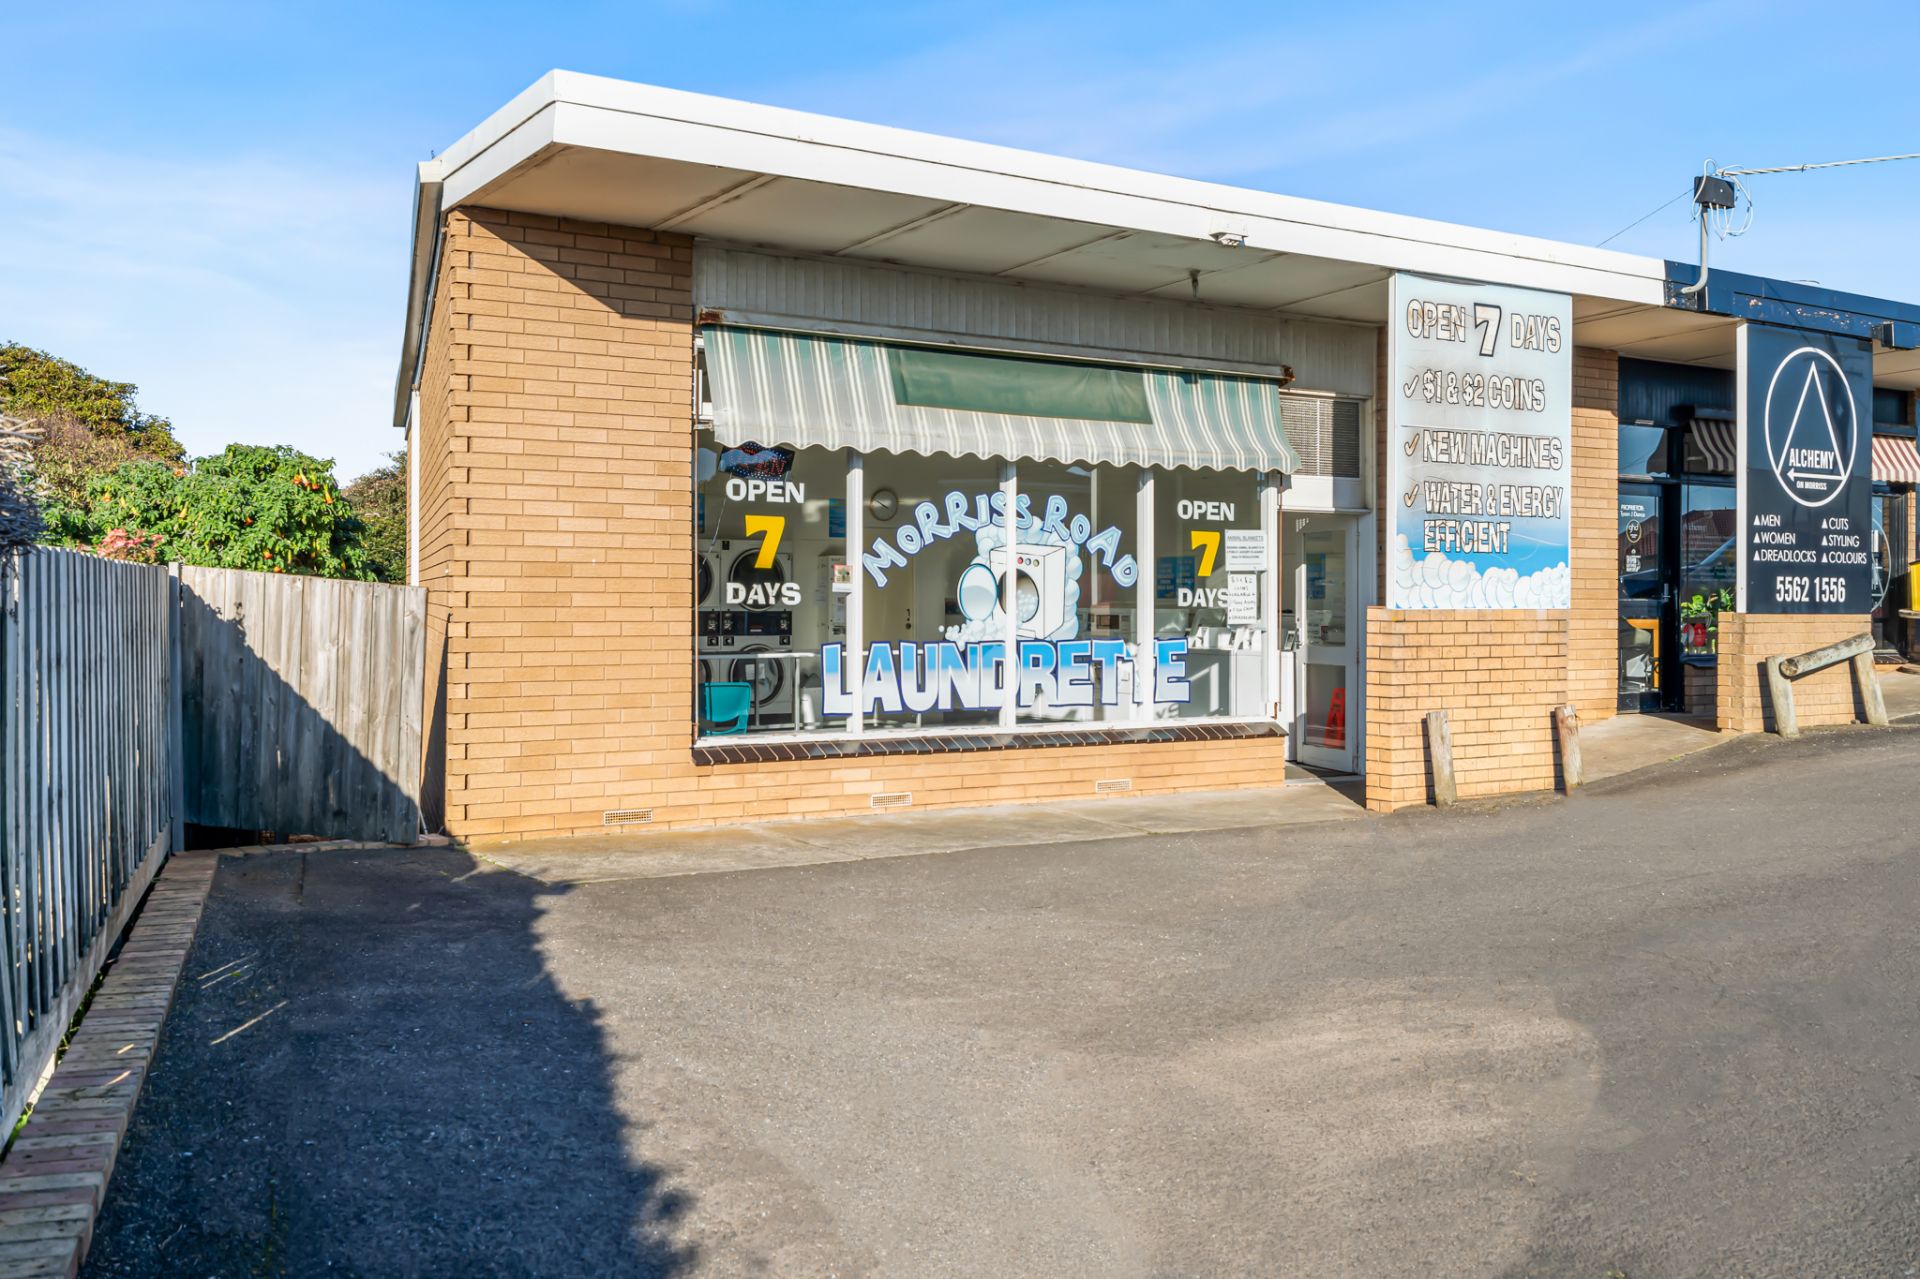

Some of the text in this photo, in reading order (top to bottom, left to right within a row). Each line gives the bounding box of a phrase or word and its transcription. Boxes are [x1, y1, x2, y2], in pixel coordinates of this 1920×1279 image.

[1407, 298, 1562, 357] OPEN 7 DAYS
[1422, 369, 1546, 412] $1 & $2 COINS
[1423, 429, 1563, 470] NEW MACHINES
[1789, 448, 1835, 470] ALCHEMY
[726, 478, 805, 504] OPEN
[1424, 480, 1564, 519] WATER & ENERGY
[1177, 499, 1235, 522] OPEN
[1760, 514, 1781, 527] MEN
[1828, 517, 1849, 530] CUTS
[745, 514, 786, 569] 7
[862, 490, 1139, 588] MORRISS ROAD
[1424, 519, 1511, 554] EFFICIENT
[1760, 531, 1796, 544] WOMEN
[1828, 535, 1860, 547] STYLING
[1191, 530, 1221, 577] 7
[1760, 549, 1817, 563] DREADLOCKS
[1828, 551, 1868, 564] COLOURS
[726, 582, 802, 606] DAYS
[1177, 587, 1227, 608] DAYS
[1776, 576, 1846, 602] 5562 1556
[821, 638, 1191, 716] LAUNDRETTE
